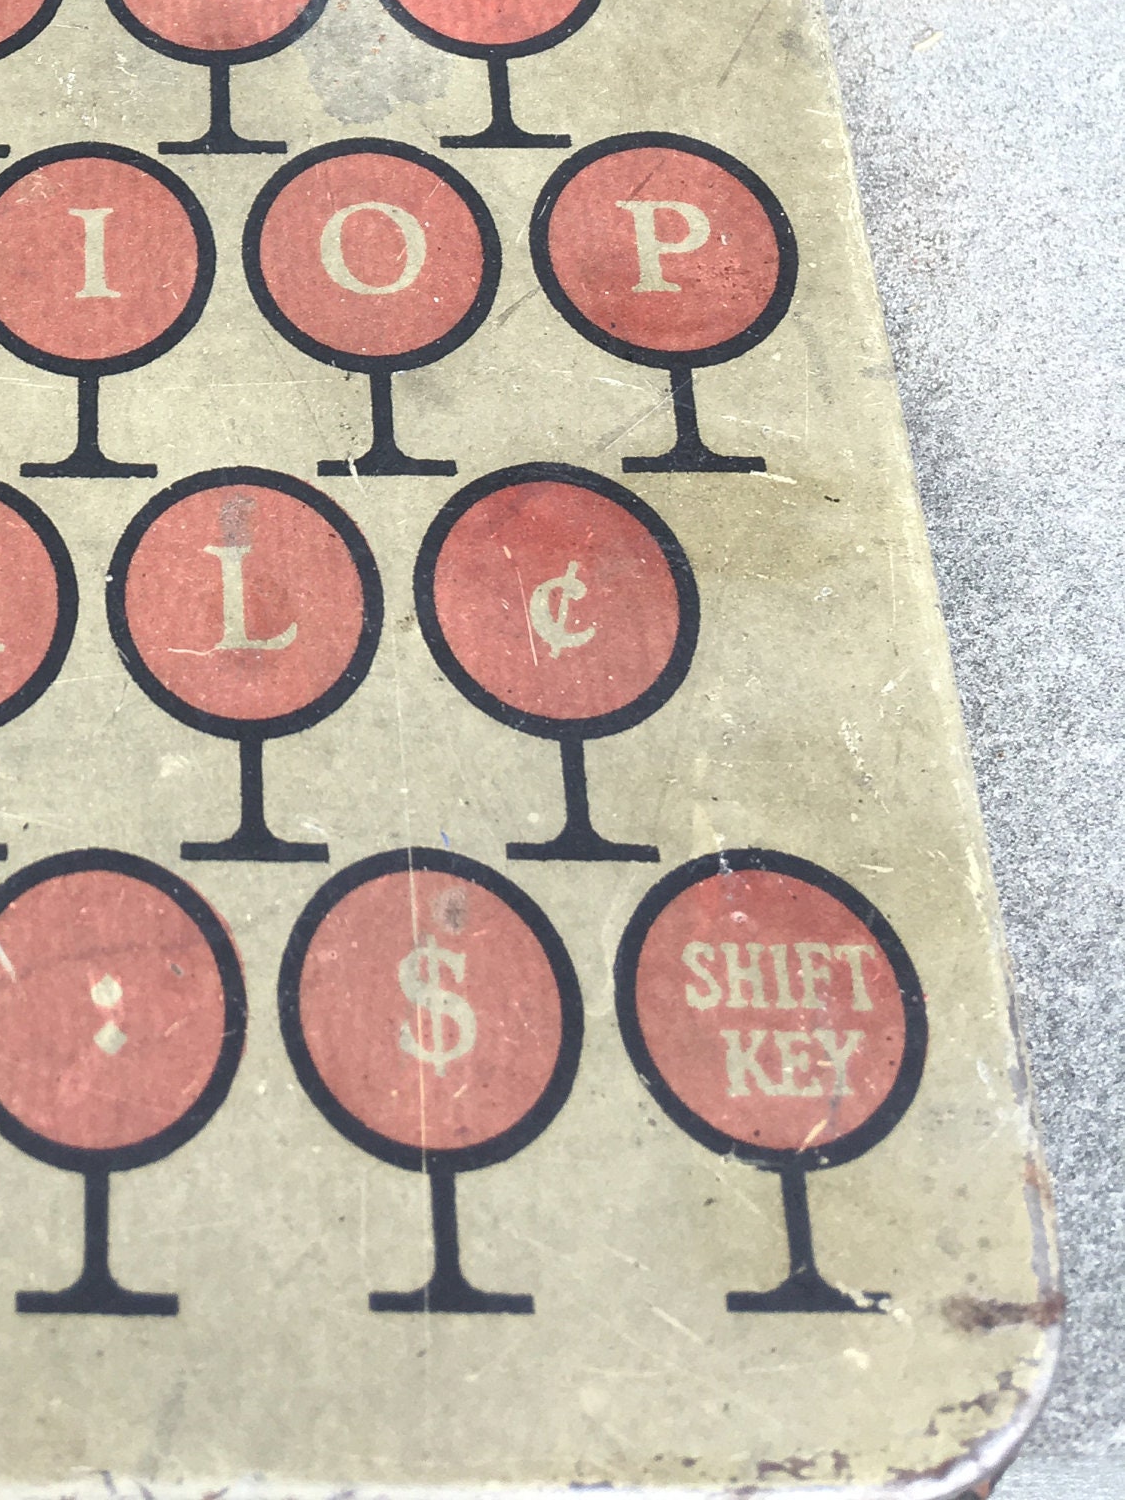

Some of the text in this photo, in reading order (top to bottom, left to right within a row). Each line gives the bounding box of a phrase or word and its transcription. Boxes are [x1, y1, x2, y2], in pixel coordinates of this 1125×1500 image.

[67, 207, 121, 298] I
[320, 201, 427, 295] O
[615, 200, 711, 293] P
[204, 545, 298, 650] L
[398, 934, 476, 1077] $
[681, 940, 878, 1012] SHIFT
[719, 1029, 866, 1098] KEY
